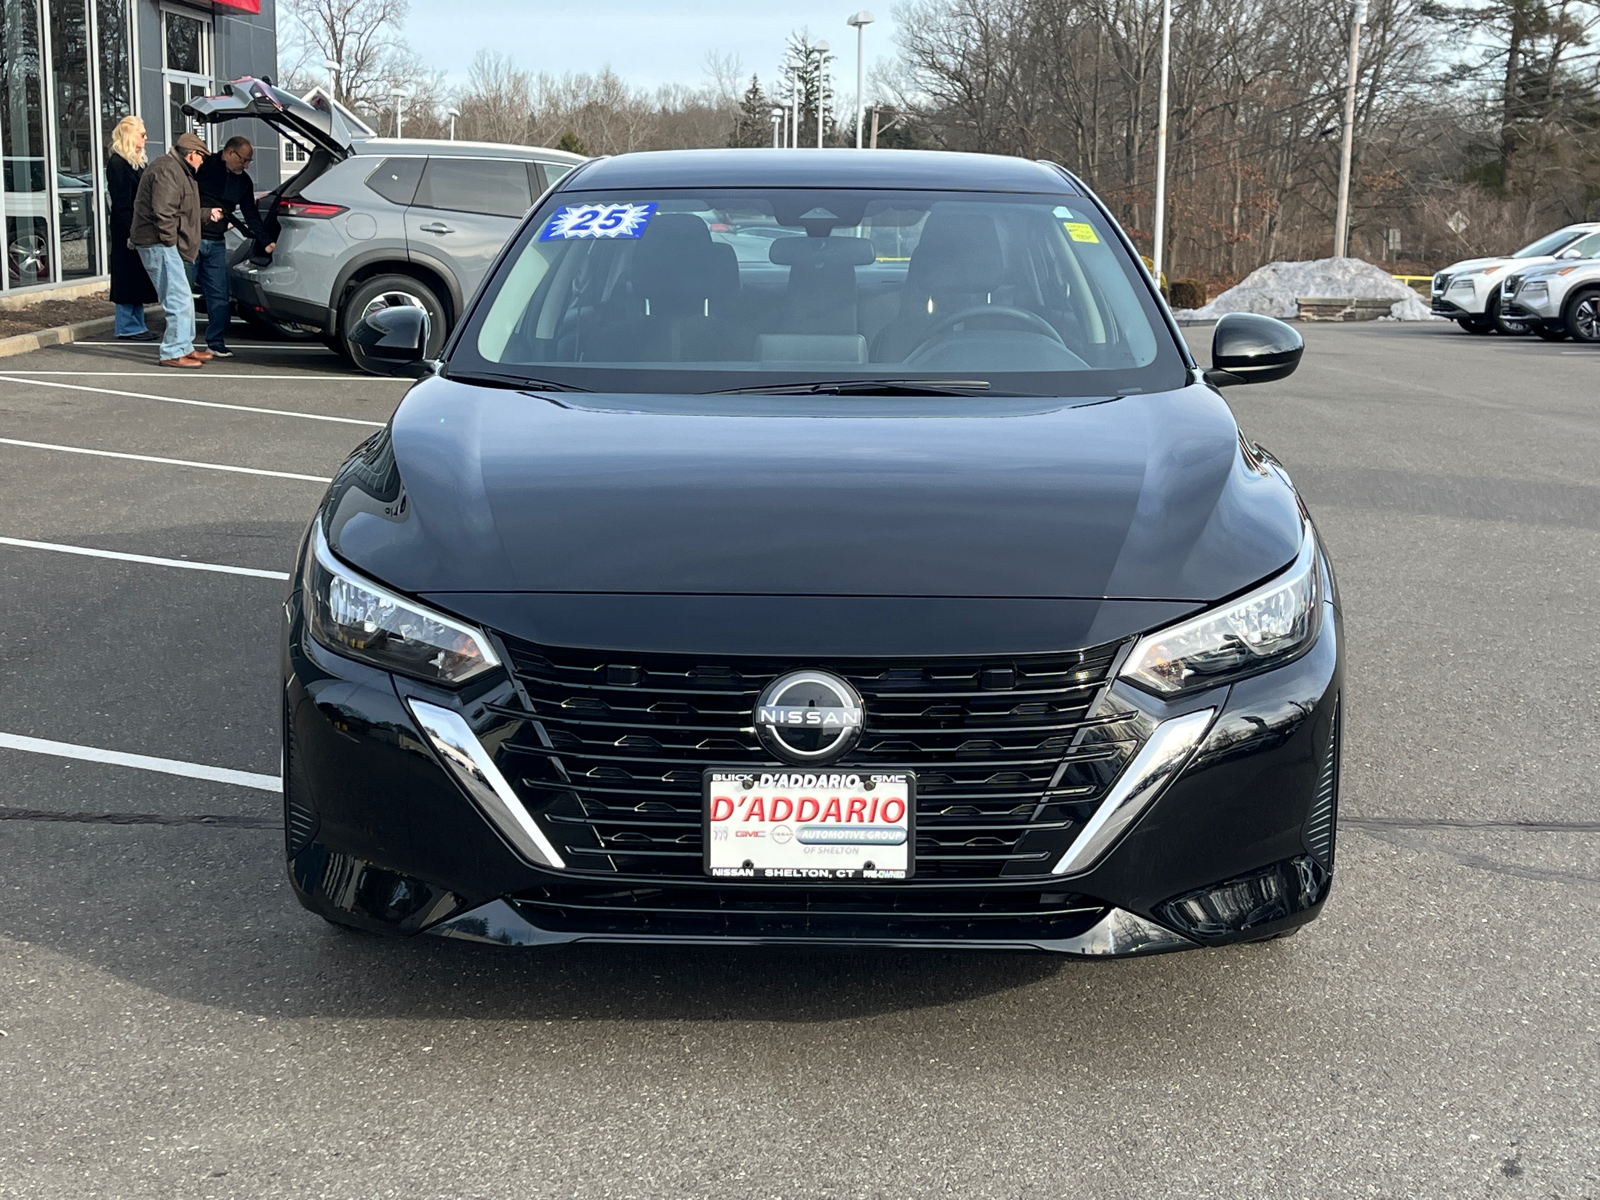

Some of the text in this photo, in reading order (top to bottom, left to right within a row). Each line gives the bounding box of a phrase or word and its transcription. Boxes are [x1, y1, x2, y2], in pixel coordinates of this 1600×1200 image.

[568, 209, 628, 231] 25
[760, 709, 858, 724] NISSAN
[712, 773, 907, 789] BUICK D'ADDARIO GMC
[710, 796, 906, 823] D'ADDARIO
[735, 830, 766, 838] GMC
[801, 829, 866, 840] AUTOMOTIVE
[866, 830, 903, 840] GROUP
[803, 846, 860, 855] OF SHELTON
[712, 868, 754, 877] NISSAN
[764, 869, 833, 879] SHELTON,
[836, 869, 855, 878] CT
